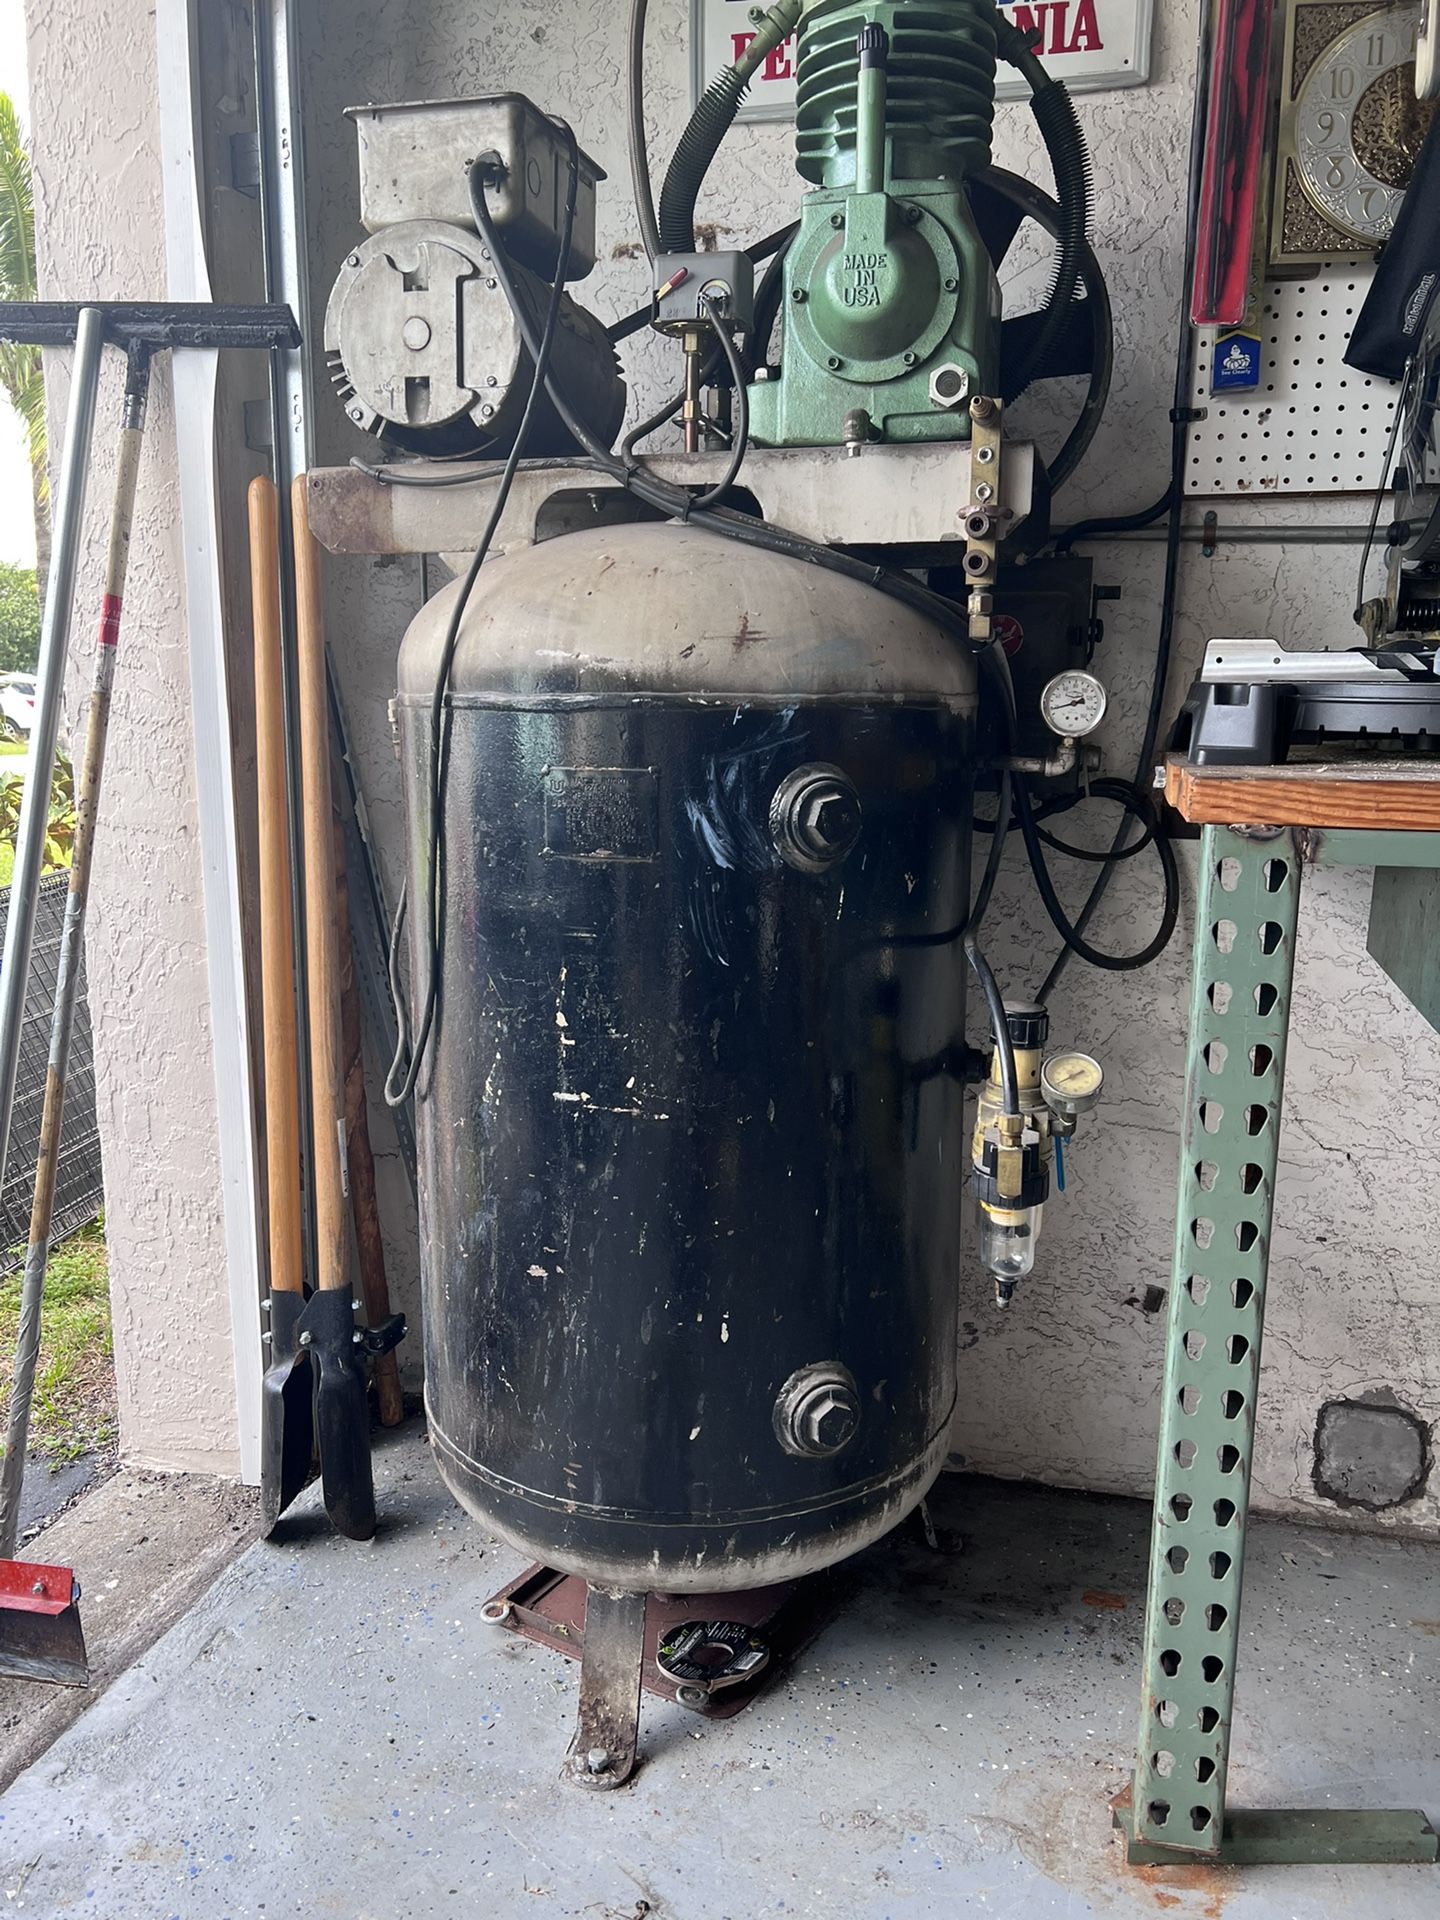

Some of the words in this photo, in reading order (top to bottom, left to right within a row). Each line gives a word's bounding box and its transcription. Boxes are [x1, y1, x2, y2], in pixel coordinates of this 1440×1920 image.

[1366, 33, 1385, 66] 11
[1329, 67, 1355, 99] 10
[1317, 112, 1334, 143] 9
[1325, 156, 1345, 188] 8
[1358, 187, 1379, 220] 7
[843, 253, 887, 270] MADE
[854, 269, 875, 287] IN
[843, 286, 881, 308] USA
